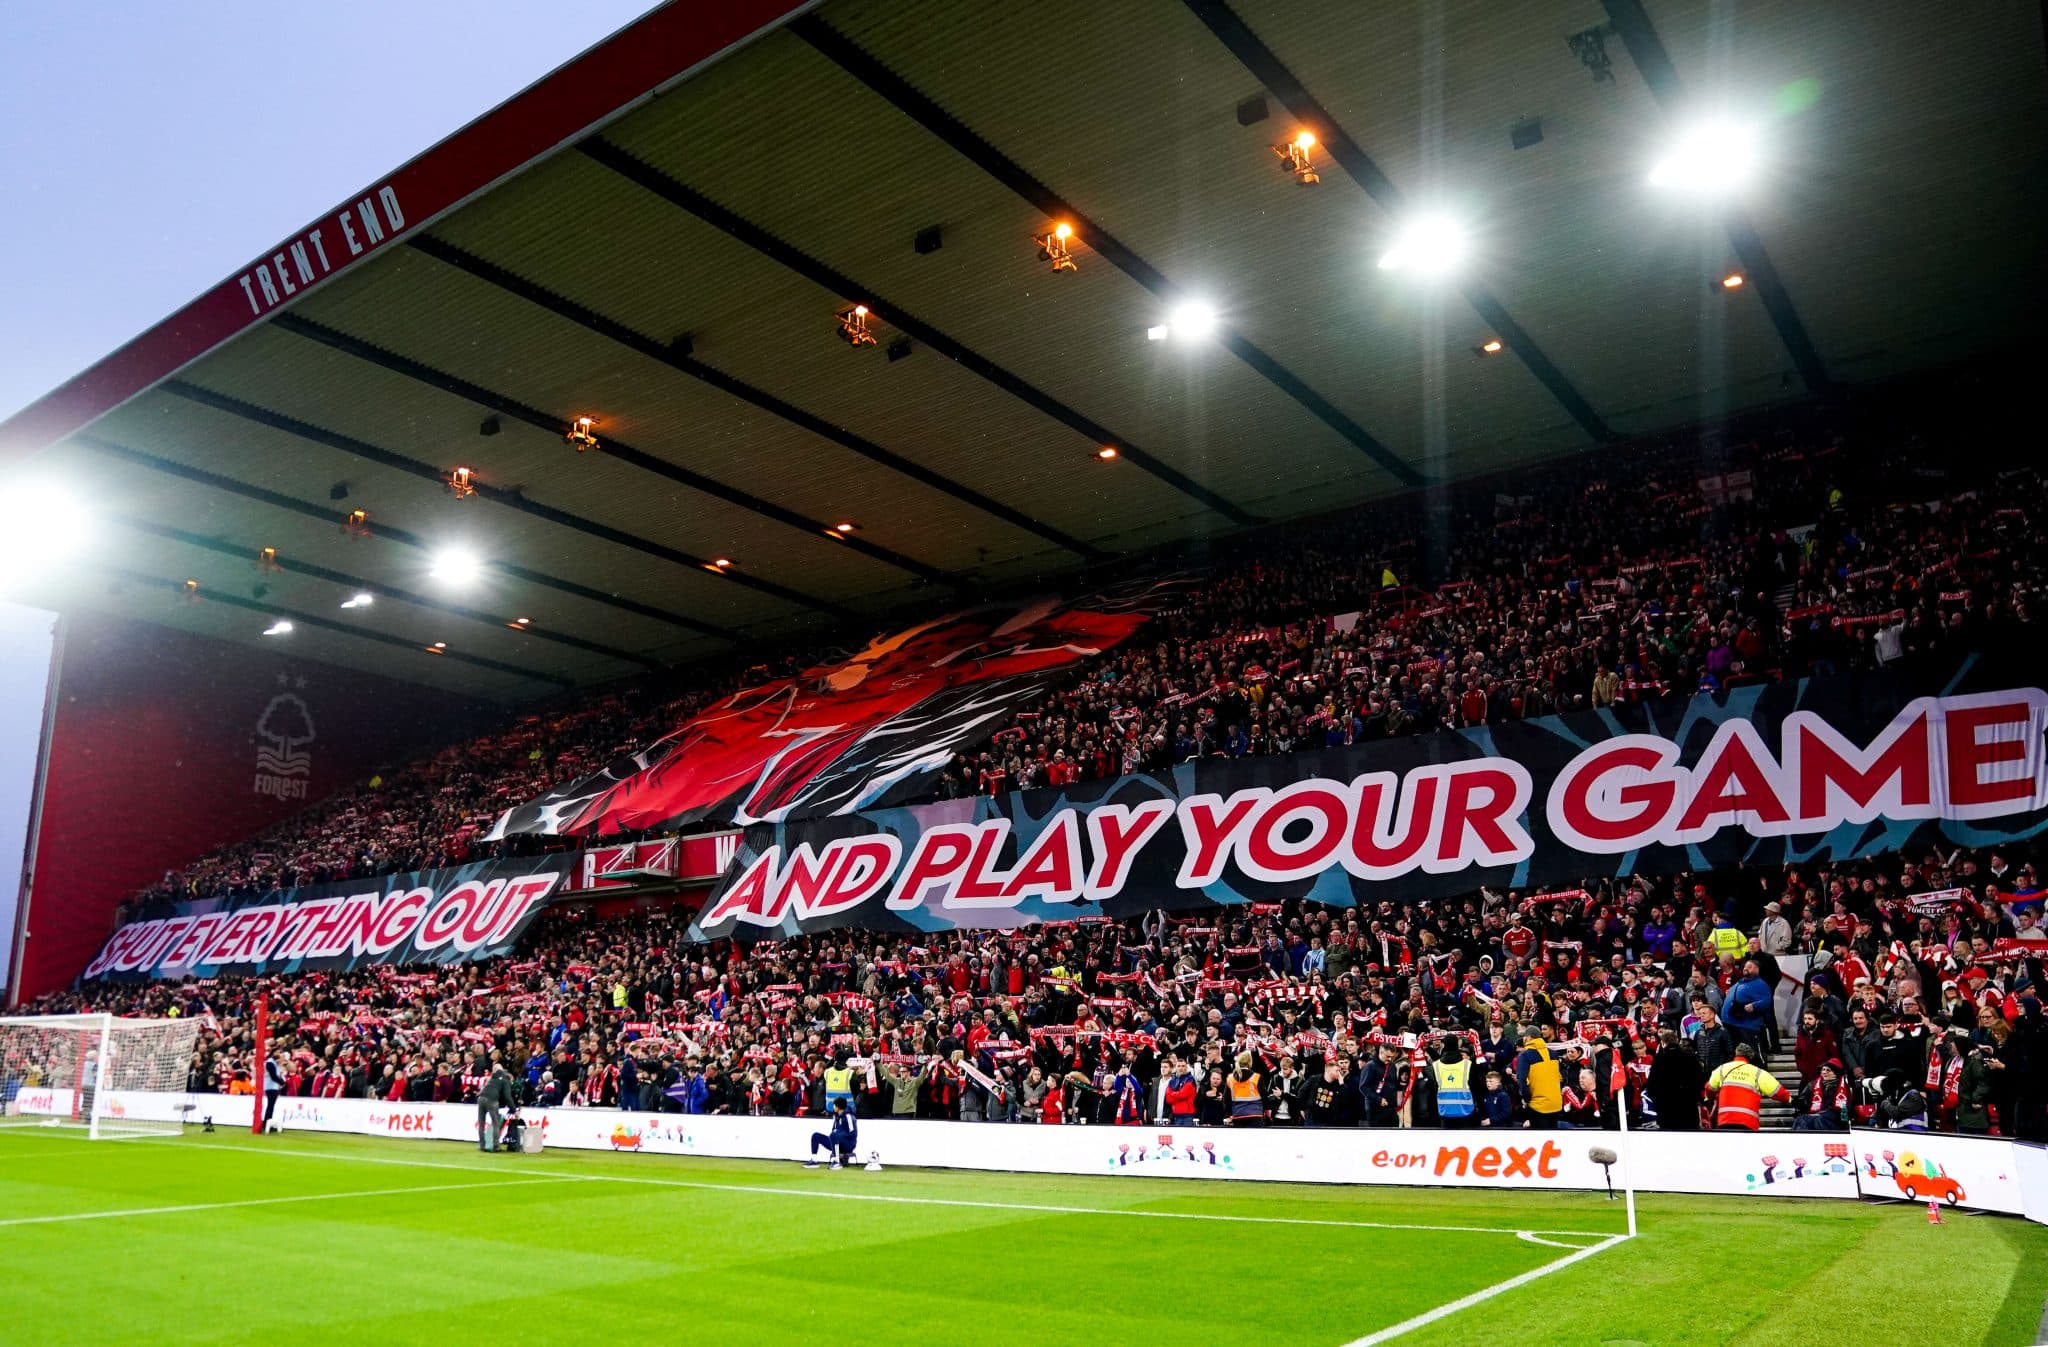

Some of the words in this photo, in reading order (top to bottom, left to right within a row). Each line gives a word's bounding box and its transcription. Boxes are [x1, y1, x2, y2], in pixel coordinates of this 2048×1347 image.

[240, 229, 330, 315] TRENT
[339, 185, 406, 256] END
[700, 833, 902, 928] AND
[886, 799, 1176, 909] PLAY
[1175, 757, 1535, 890] YOUR
[1546, 687, 2048, 854] GAME
[85, 913, 195, 979] SHUT
[161, 886, 427, 969] EVERYTHING
[415, 872, 559, 952] OUT
[388, 1111, 434, 1132] next
[1433, 1140, 1562, 1179] next
